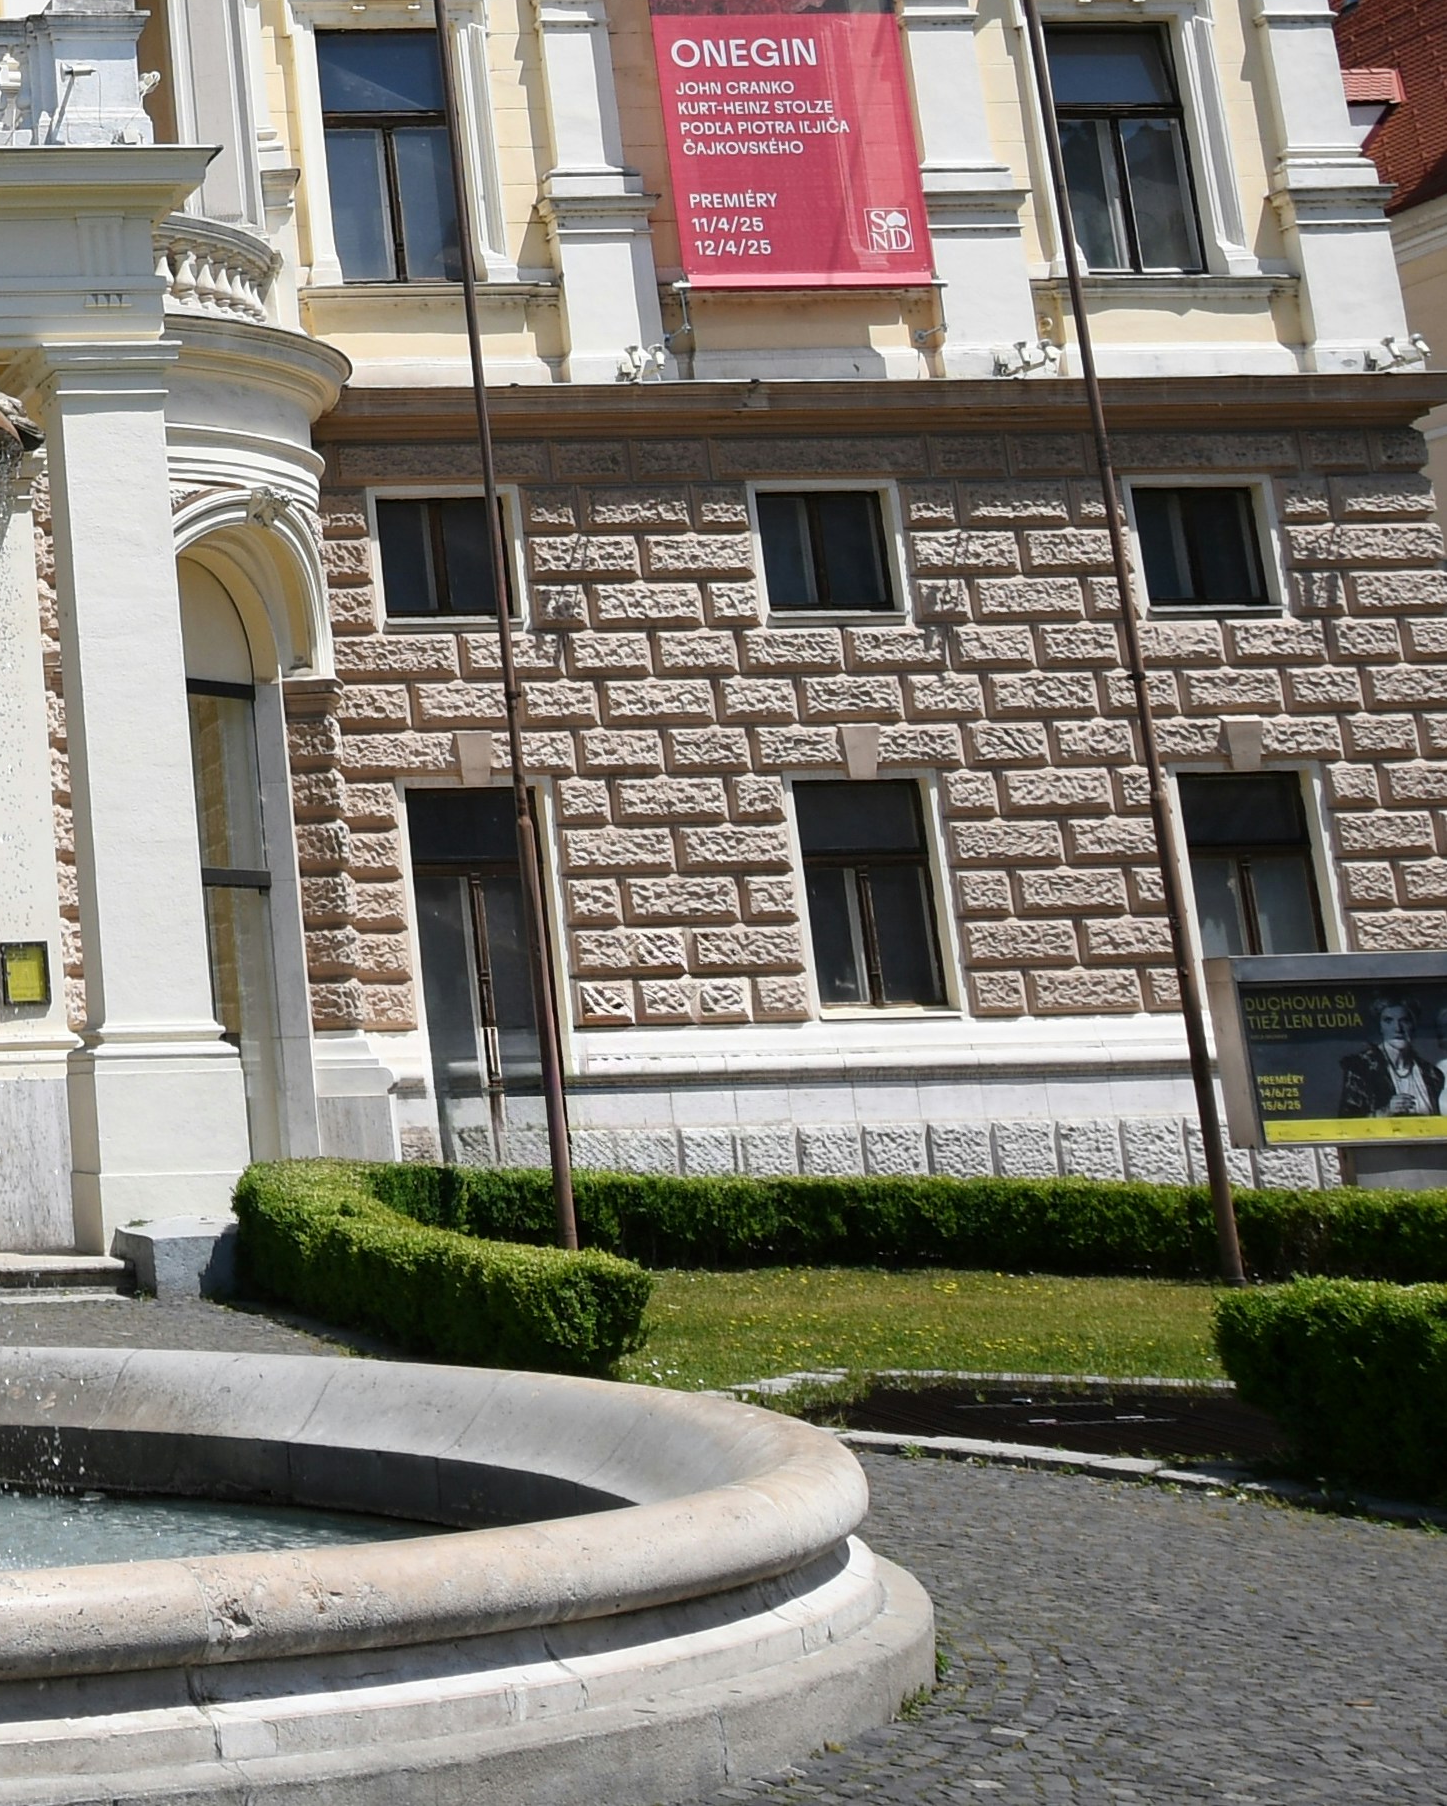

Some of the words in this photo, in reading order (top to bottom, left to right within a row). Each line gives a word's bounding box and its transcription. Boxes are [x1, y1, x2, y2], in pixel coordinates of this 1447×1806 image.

[670, 37, 818, 68] ONEGIN
[675, 81, 721, 96] JOHN
[725, 80, 795, 95] CRANKO
[677, 101, 771, 116] KURT-HEINZ
[773, 99, 834, 115] STOLZE
[680, 120, 734, 136] PODĽA
[737, 120, 795, 135] PIOTRA
[798, 116, 850, 135] IĽJIČA
[682, 136, 804, 157] ČAJKOVSKÉHO
[688, 188, 778, 209] PREMIÉRY
[691, 215, 764, 233] 11/4/25
[694, 238, 772, 256] 12/4/25
[1243, 994, 1332, 1012] DUCHOVIA
[1246, 1012, 1281, 1030] TIEŽ
[1283, 1014, 1313, 1030] LEN
